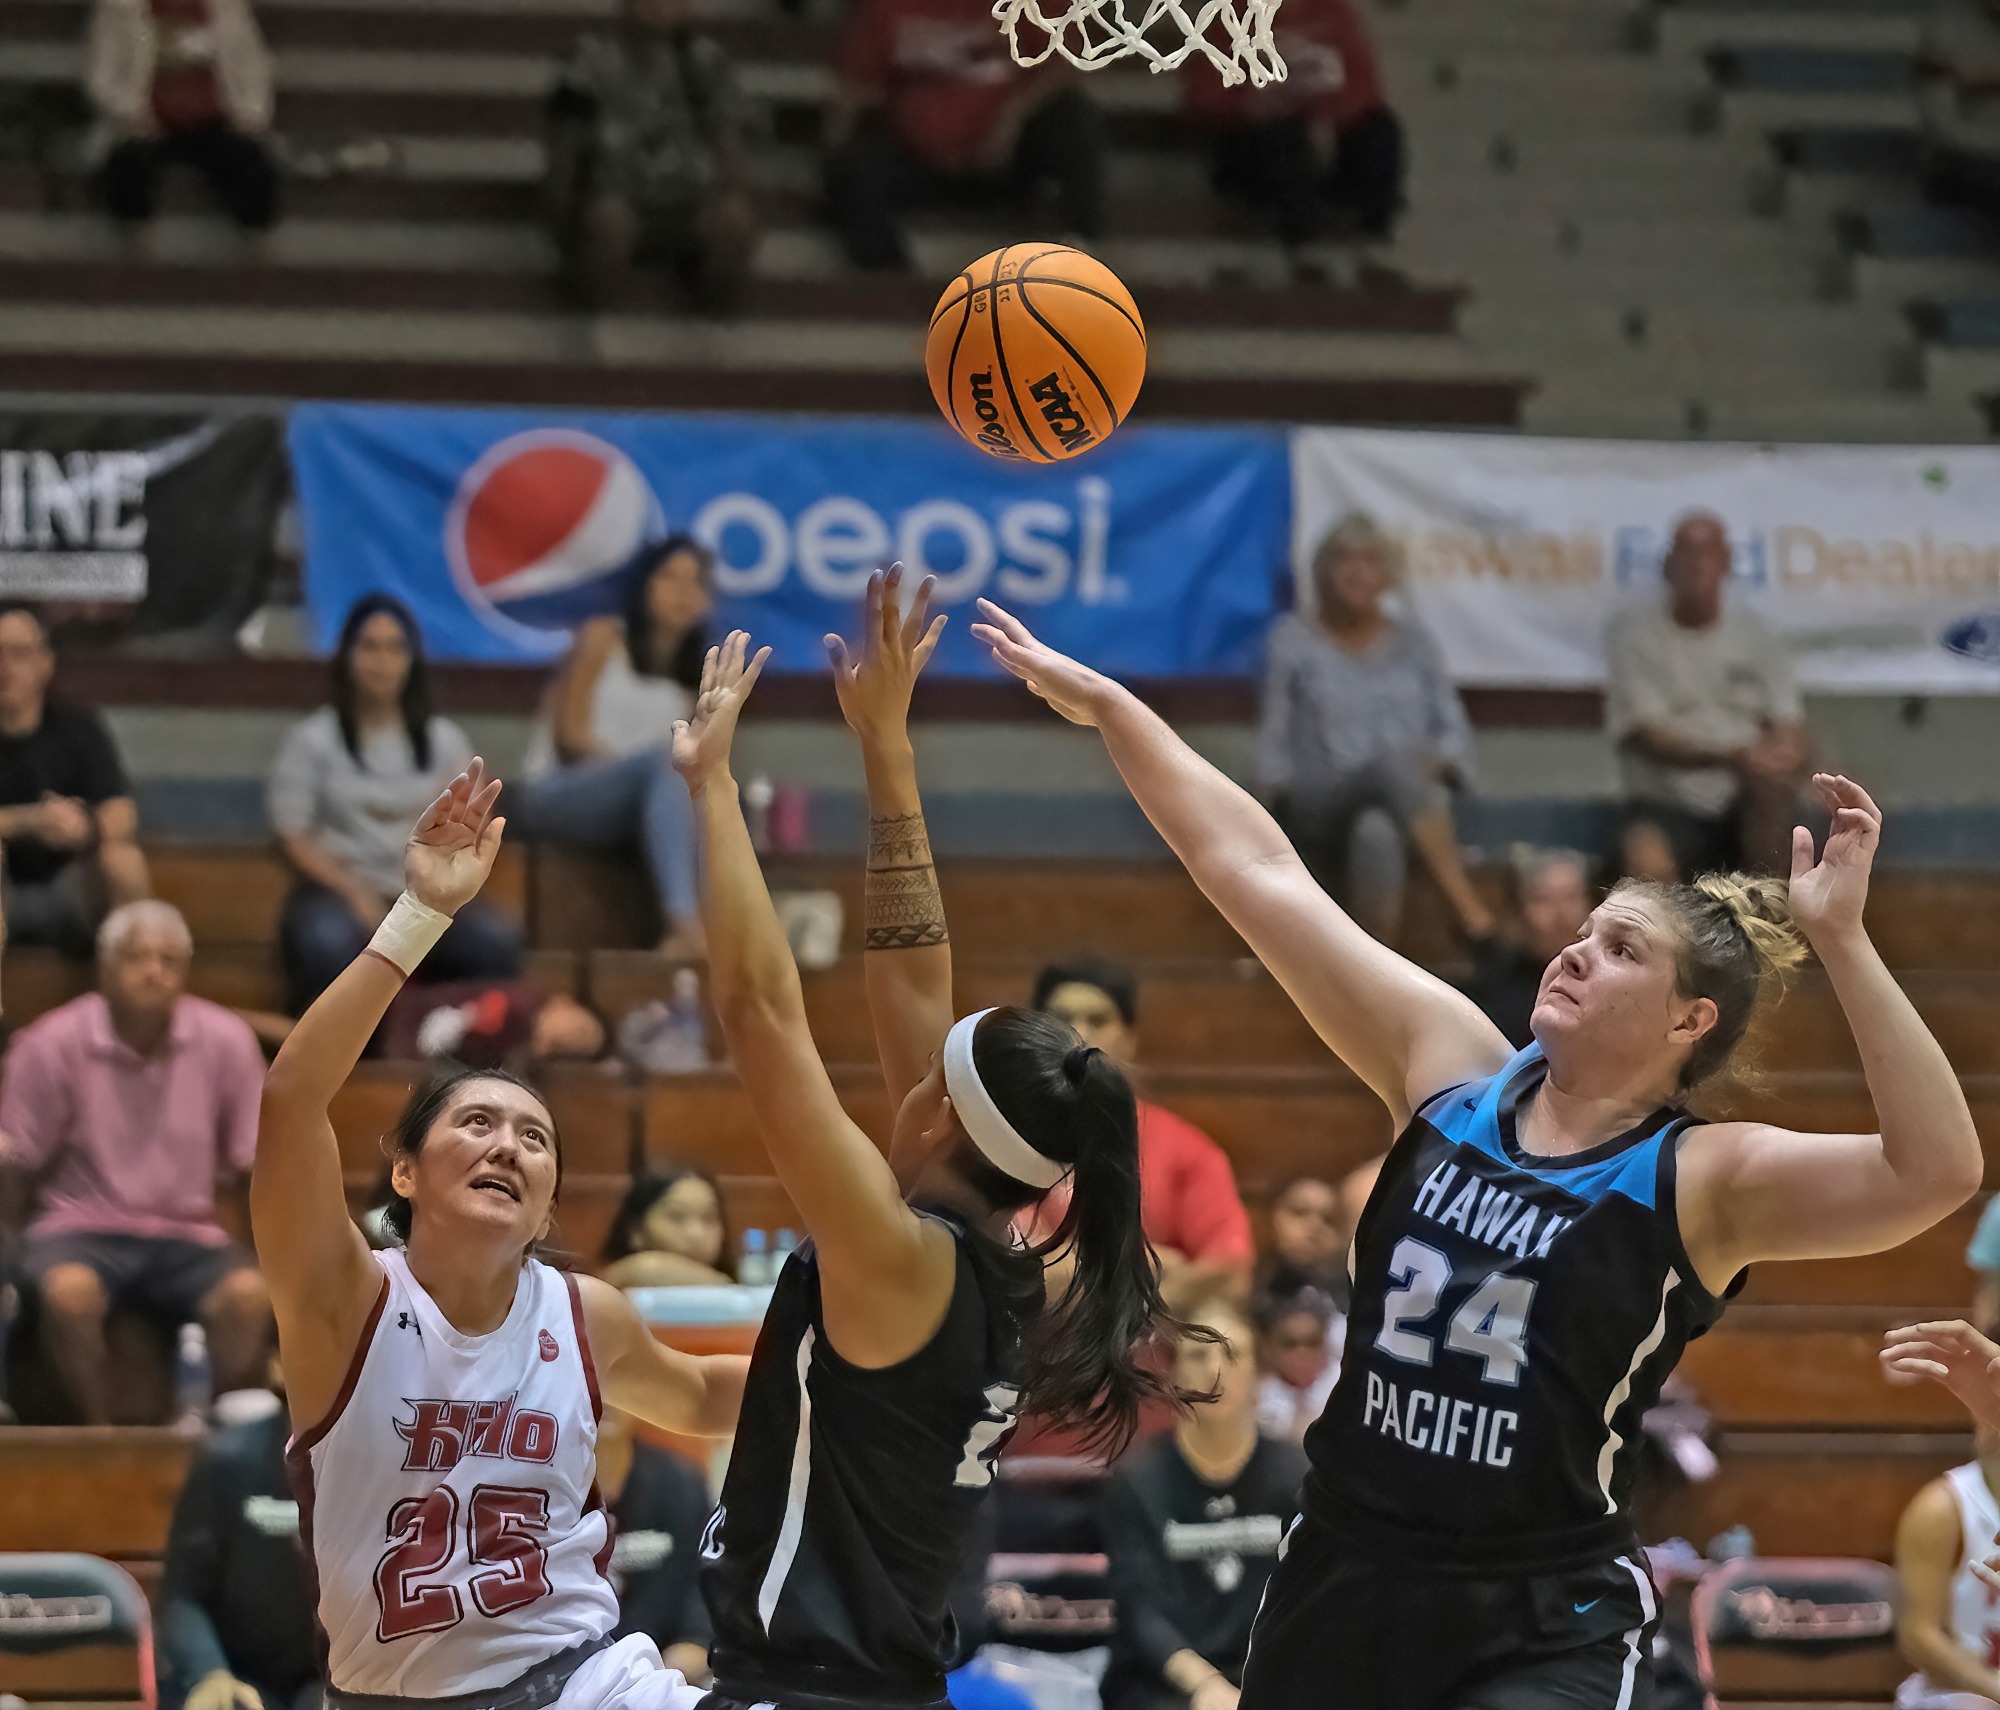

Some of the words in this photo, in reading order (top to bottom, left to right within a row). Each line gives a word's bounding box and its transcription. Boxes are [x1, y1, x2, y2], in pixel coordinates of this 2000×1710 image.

[969, 371, 1024, 461] ilson
[1028, 371, 1096, 453] NCAA
[1372, 1235, 1539, 1388] 24
[392, 1390, 560, 1471] Hilo
[1362, 1370, 1519, 1468] PACIFIC
[372, 1483, 554, 1645] 25
